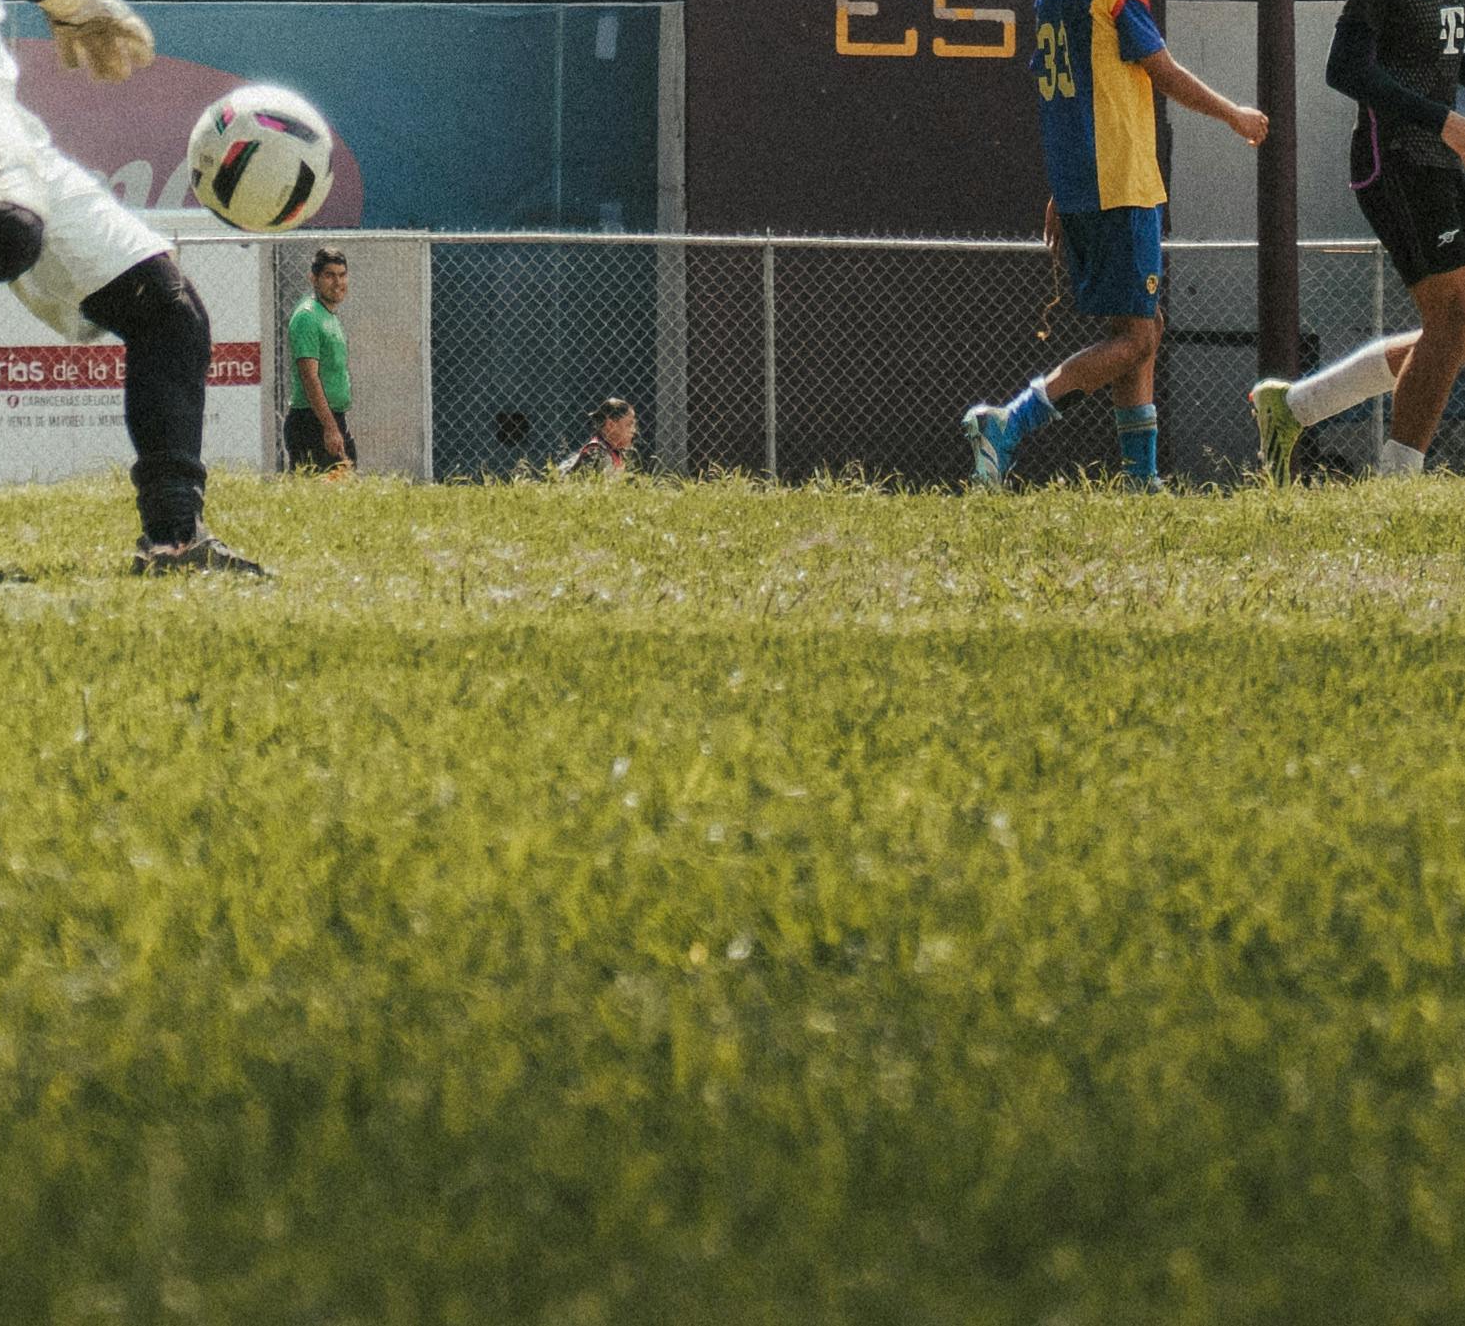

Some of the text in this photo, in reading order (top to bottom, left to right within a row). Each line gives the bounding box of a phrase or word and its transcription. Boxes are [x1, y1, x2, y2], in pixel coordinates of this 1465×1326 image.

[1037, 20, 1076, 101] 33
[52, 359, 78, 381] de
[87, 358, 107, 381] la
[207, 360, 254, 377] arne
